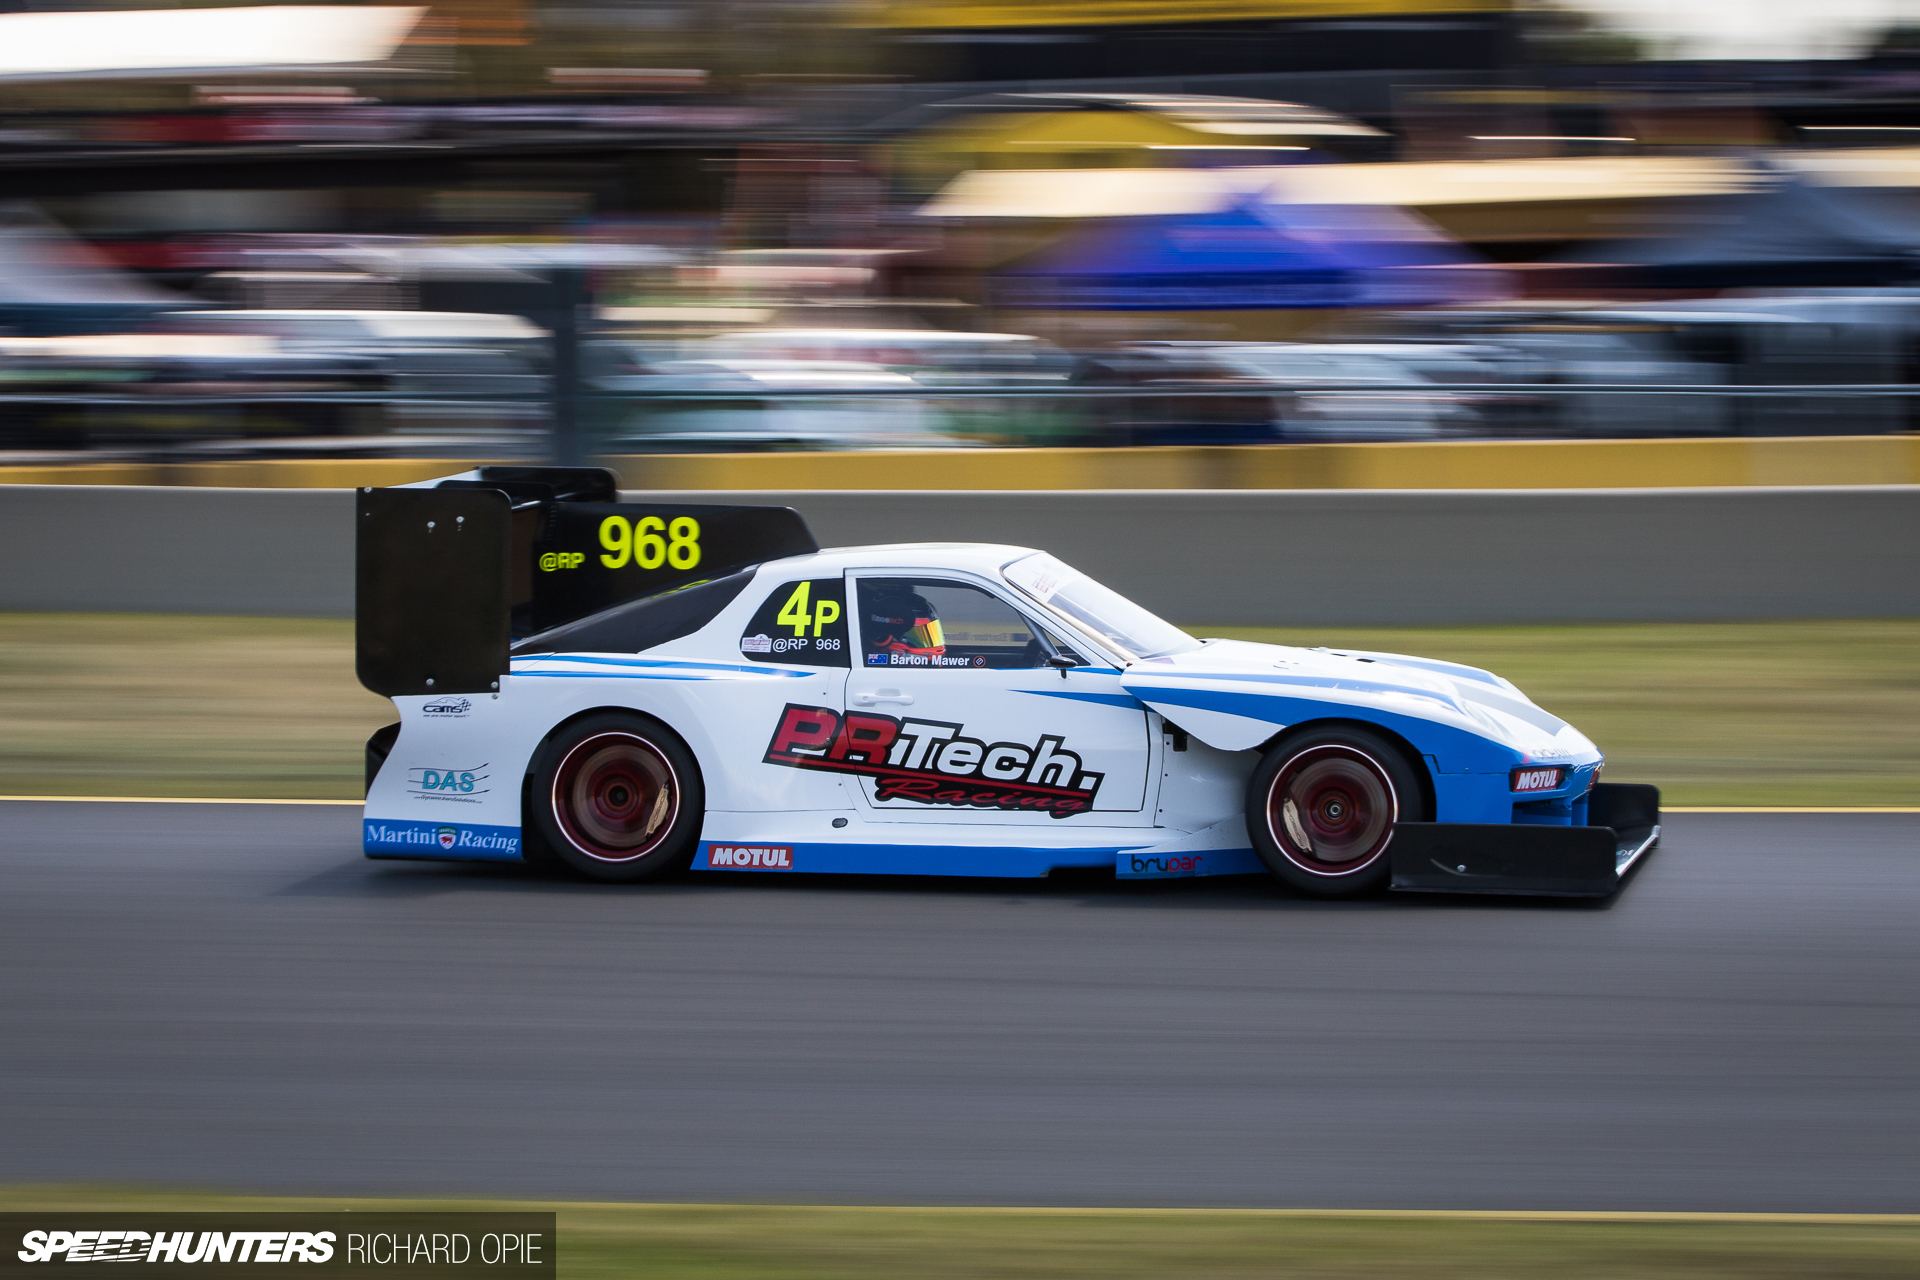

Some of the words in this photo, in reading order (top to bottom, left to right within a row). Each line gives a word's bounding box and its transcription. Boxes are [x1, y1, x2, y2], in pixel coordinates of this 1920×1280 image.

[539, 552, 585, 572] @RP
[599, 515, 701, 570] 968
[772, 638, 808, 653] @RP
[815, 638, 841, 650] 968
[890, 654, 928, 665] Barton
[931, 654, 970, 665] Mawer
[422, 770, 474, 792] DAS
[1516, 770, 1557, 790] MOTUL
[877, 777, 1089, 816] Racing
[366, 824, 438, 845] Martini
[458, 829, 519, 853] Racing
[711, 847, 790, 867] MOTUL
[1131, 854, 1203, 873] brupar
